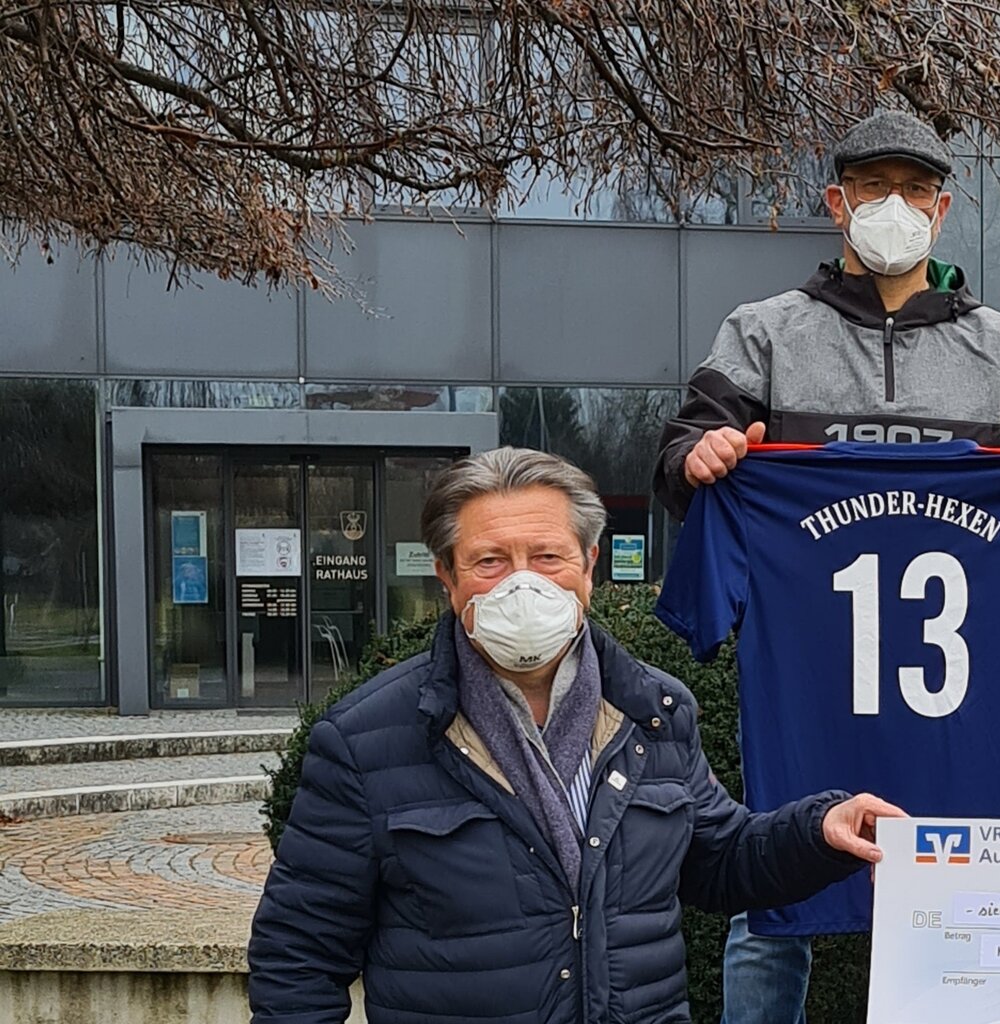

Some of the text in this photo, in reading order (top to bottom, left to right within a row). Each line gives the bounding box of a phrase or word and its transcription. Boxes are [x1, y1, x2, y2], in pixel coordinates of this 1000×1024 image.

[316, 555, 366, 566] EINGANG
[316, 569, 368, 580] RATHAUS
[833, 551, 970, 718] 13
[912, 910, 942, 928] DE
[944, 931, 972, 942] Betrag
